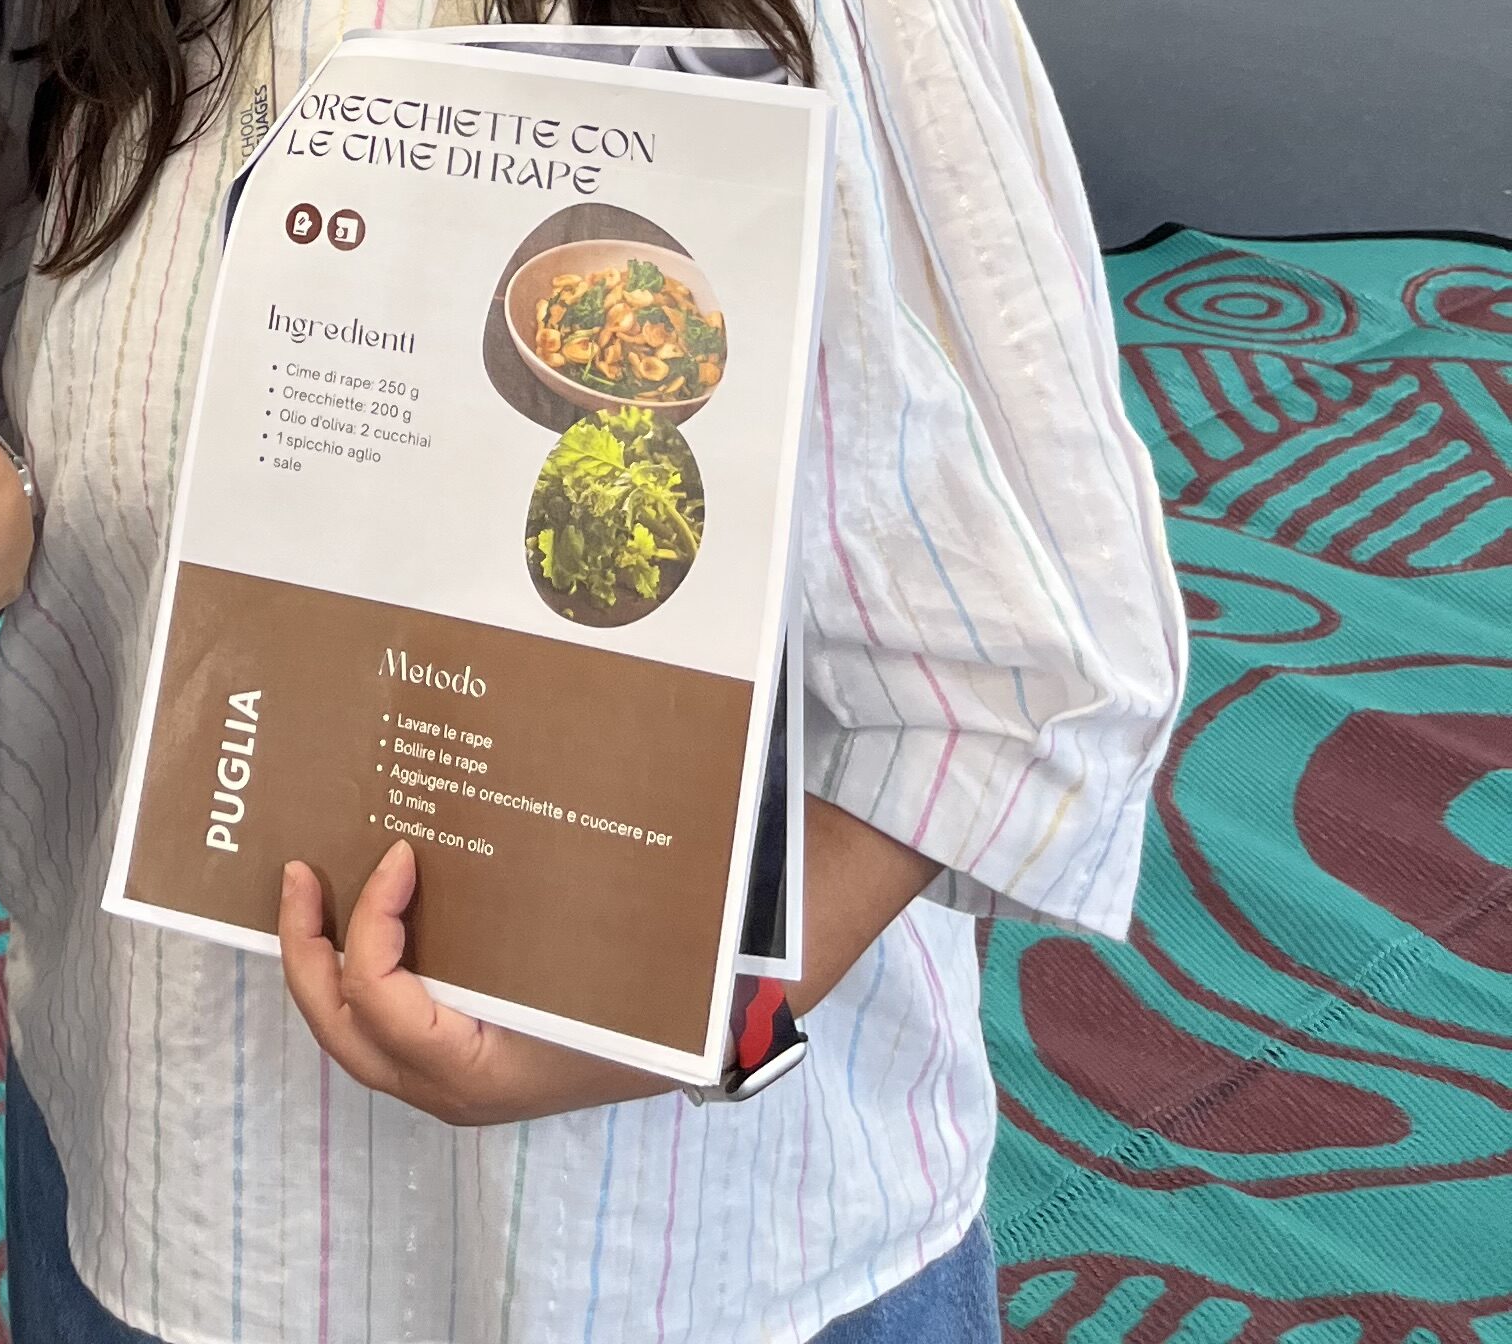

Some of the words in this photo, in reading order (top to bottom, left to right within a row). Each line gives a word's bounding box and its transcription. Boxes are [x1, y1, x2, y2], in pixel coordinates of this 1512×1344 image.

[240, 103, 254, 166] CHOOL
[255, 84, 268, 146] UAGES
[300, 94, 560, 148] ORECCHIETTE
[571, 125, 656, 163] CON
[287, 129, 334, 157] LE
[342, 134, 438, 171] CIME
[446, 146, 482, 179] DI
[490, 152, 602, 195] RAPE
[268, 304, 415, 354] Ingredienti
[286, 363, 321, 381] Cime
[324, 370, 337, 384] di
[378, 379, 406, 396] 250
[410, 387, 420, 401] g
[283, 385, 366, 413] Orecchiette:
[371, 401, 399, 418] 200
[402, 410, 412, 424] g
[276, 432, 283, 445] 1
[286, 435, 344, 456] spicchio
[348, 446, 382, 463] aglio
[279, 408, 307, 425] Olio
[360, 424, 370, 437] 2
[374, 428, 432, 448] cucchiai
[273, 456, 302, 472] sale
[378, 648, 487, 698] Metodo
[397, 713, 441, 737] Lavare
[443, 724, 457, 741] le
[460, 729, 493, 749] rape
[206, 690, 262, 853] PUGLIA
[394, 738, 436, 761] Bollire
[439, 749, 453, 765] le
[455, 754, 488, 774] rape
[388, 789, 403, 806] 10
[406, 795, 436, 814] mins
[390, 764, 459, 792] Aggiugere
[463, 780, 476, 797] le
[479, 788, 563, 820] orecchiette
[567, 811, 577, 823] e
[580, 813, 643, 840] cuocere
[645, 827, 673, 847] per
[384, 814, 436, 841] Condire
[438, 831, 465, 848] con
[468, 838, 494, 856] olio
